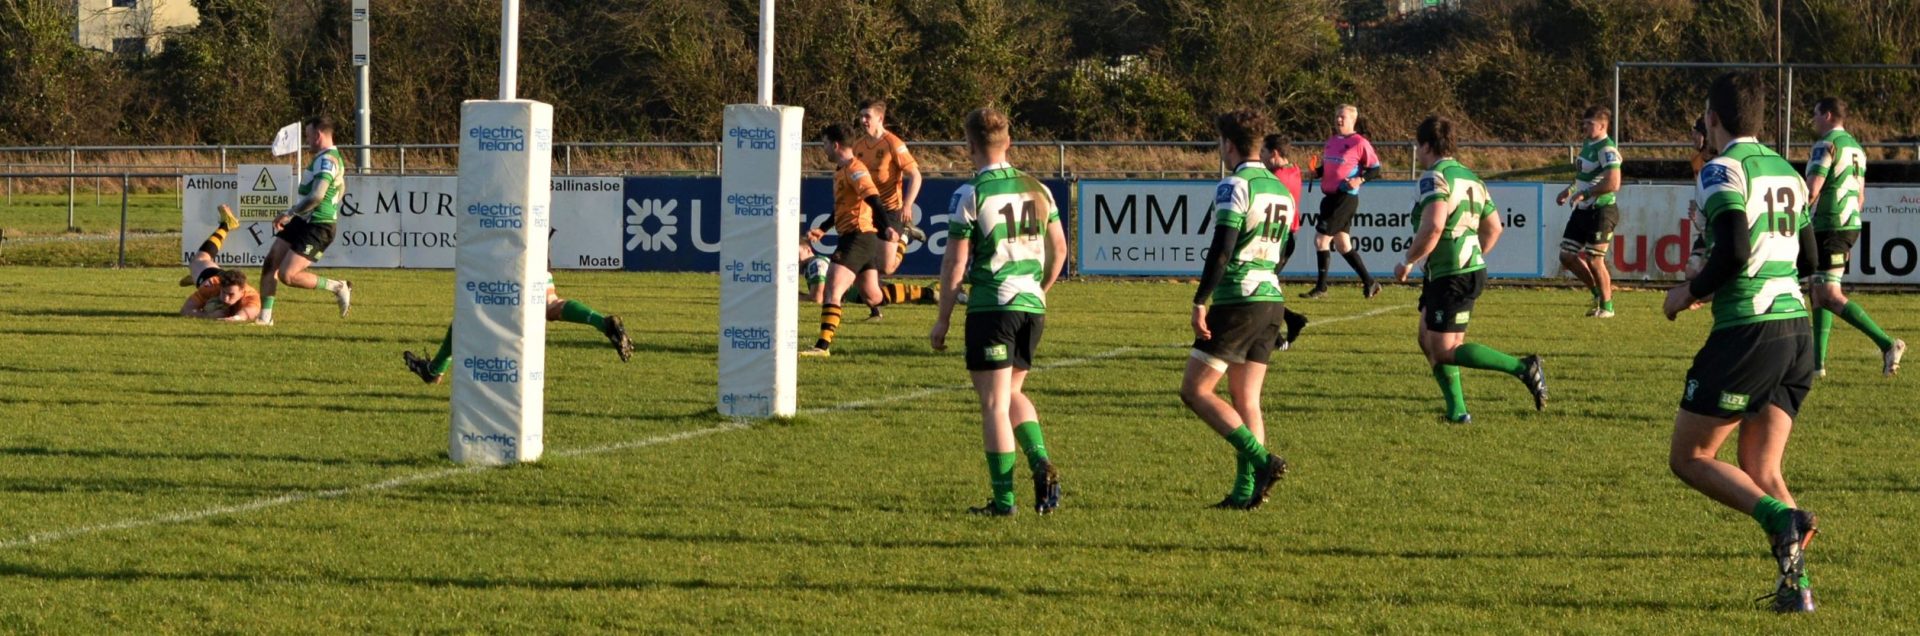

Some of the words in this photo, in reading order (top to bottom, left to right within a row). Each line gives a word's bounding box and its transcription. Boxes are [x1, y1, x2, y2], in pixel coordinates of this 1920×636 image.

[469, 126, 524, 139] electric
[729, 127, 775, 138] electric
[478, 138, 524, 152] Ireland
[736, 137, 776, 150] Irland
[186, 178, 238, 190] Athlone
[240, 195, 261, 205] KEEP
[262, 195, 288, 205] CLEAR
[340, 193, 364, 217] &
[728, 193, 774, 205] electric
[240, 208, 269, 218] ELECTRIC
[467, 203, 523, 215] electric
[734, 204, 774, 217] Ireland
[1763, 186, 1796, 239] 13
[998, 199, 1040, 243] 14
[1260, 202, 1288, 243] 15
[579, 254, 620, 267] Moate
[466, 280, 520, 292] eectric
[475, 291, 520, 306] Ireland
[724, 326, 770, 339] electric
[731, 338, 770, 350] Ireland
[463, 356, 518, 370] electric
[473, 368, 518, 383] Ireland
